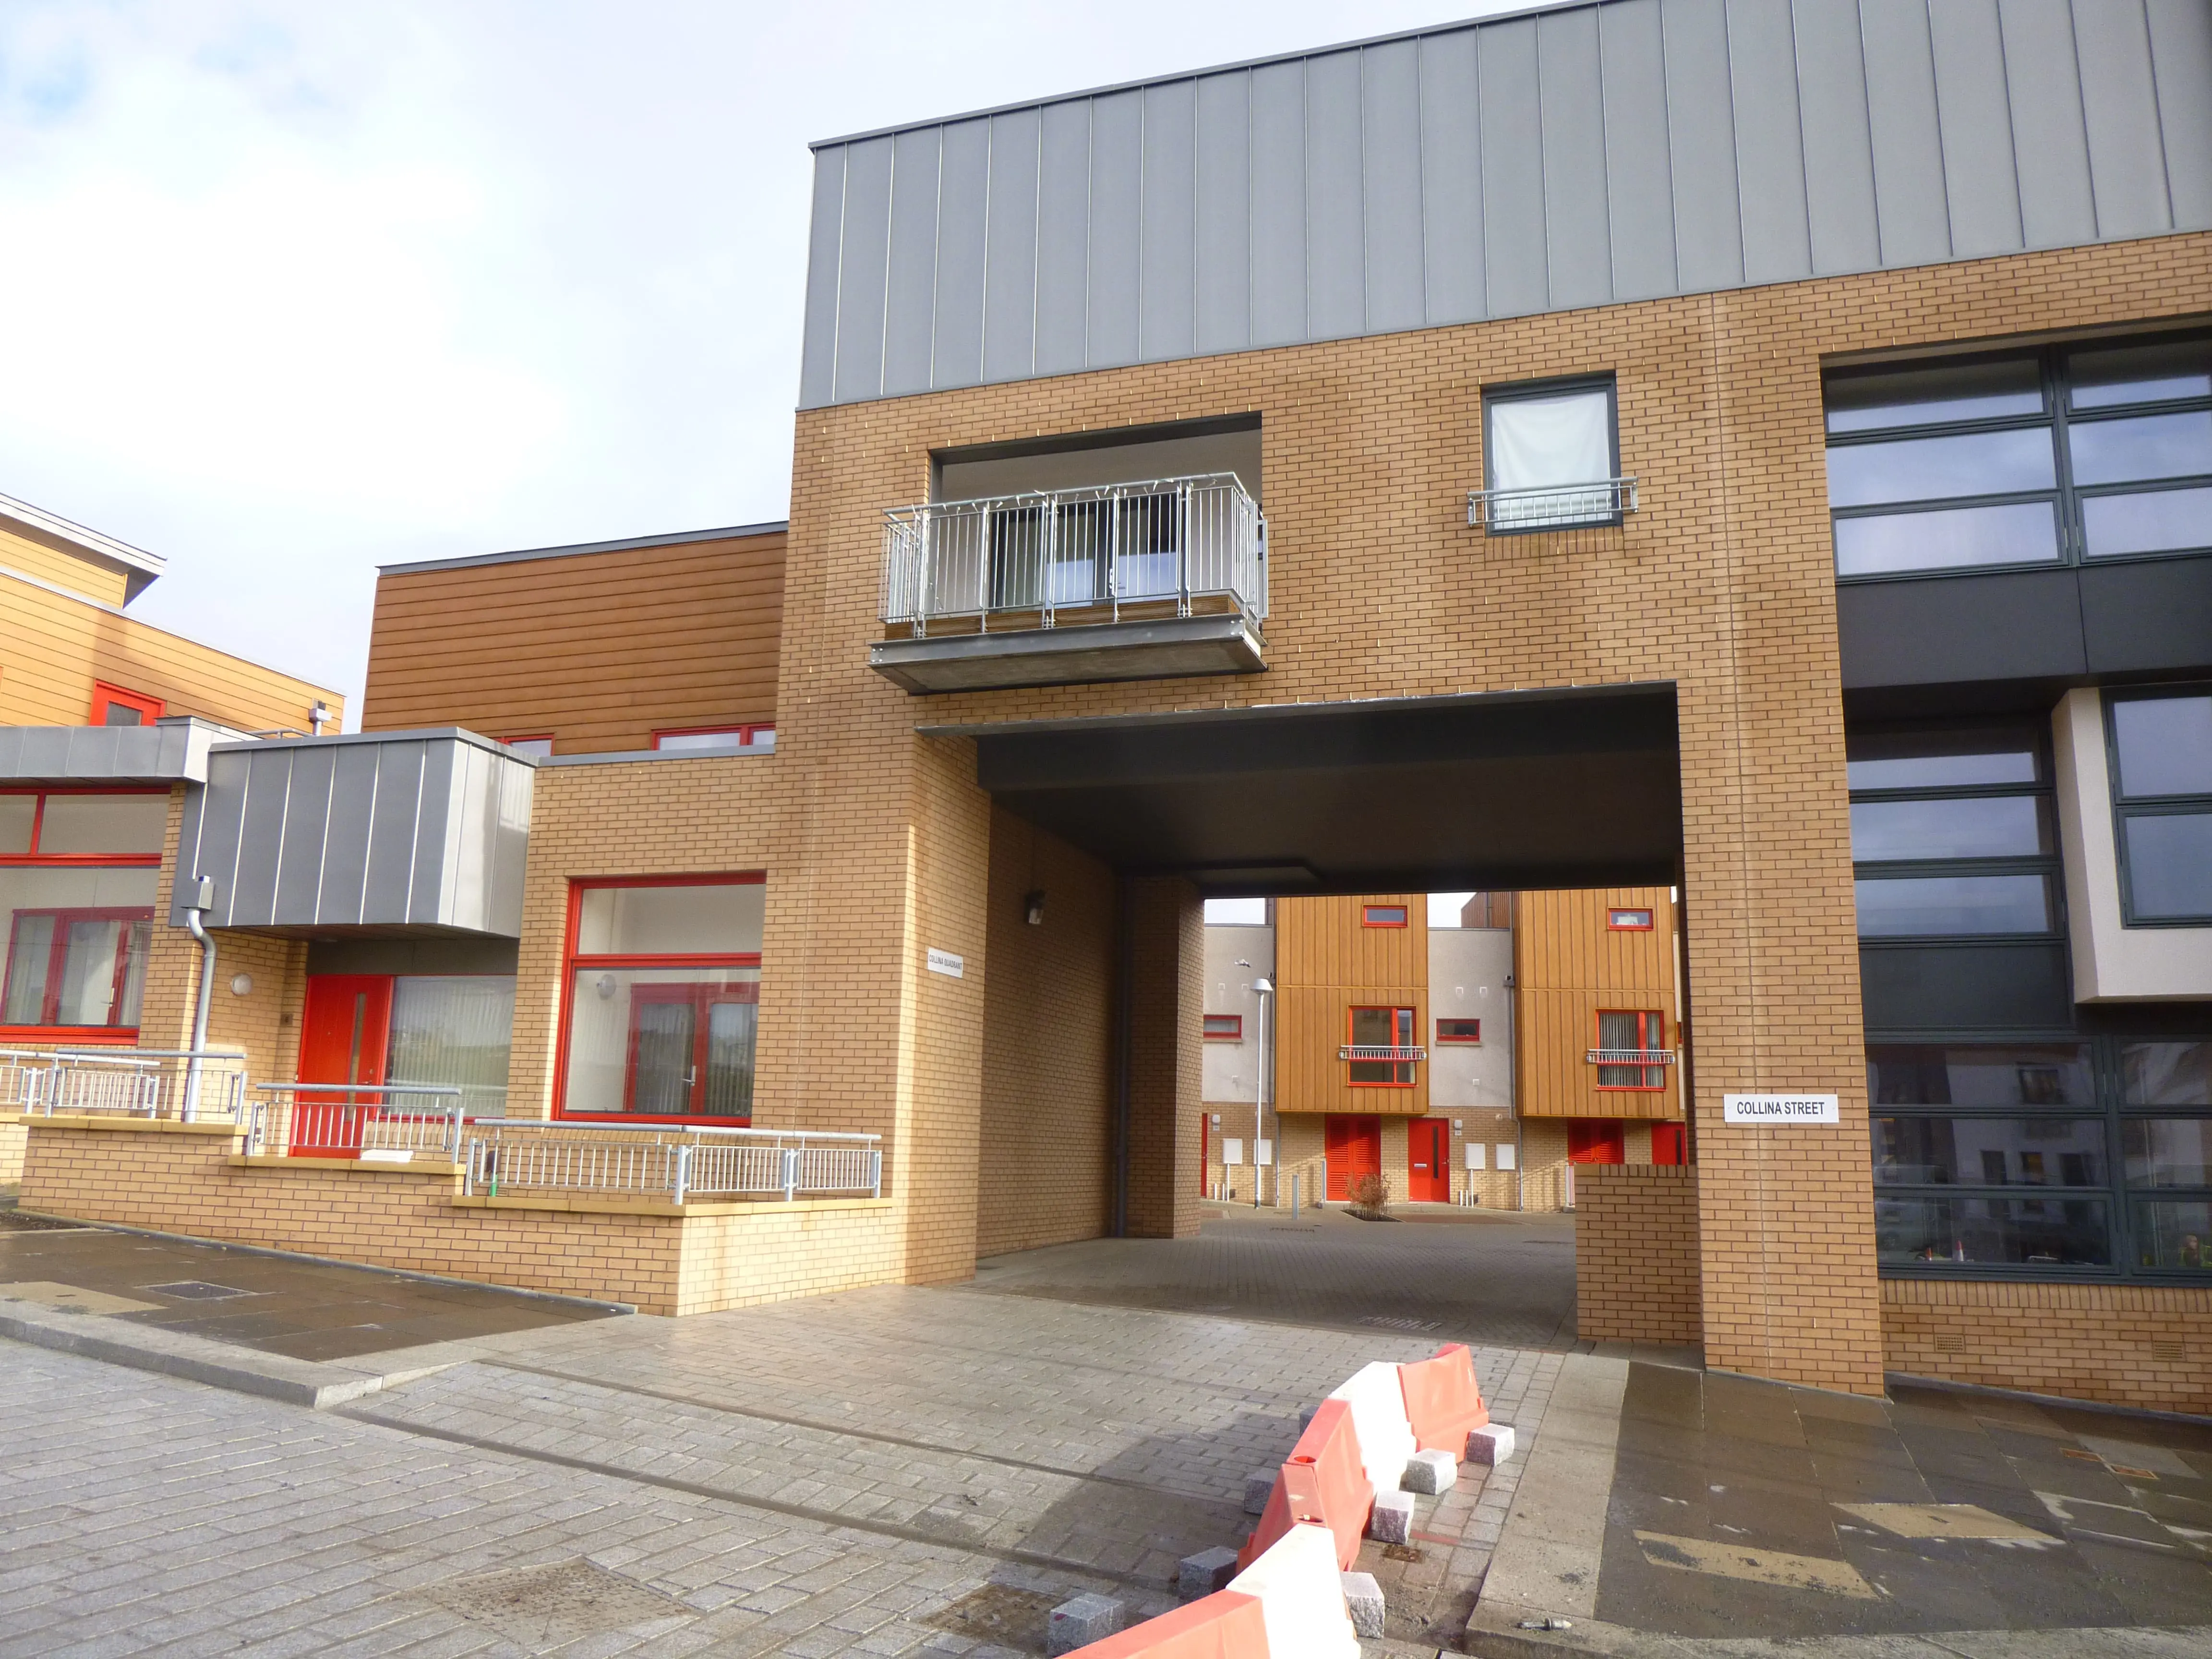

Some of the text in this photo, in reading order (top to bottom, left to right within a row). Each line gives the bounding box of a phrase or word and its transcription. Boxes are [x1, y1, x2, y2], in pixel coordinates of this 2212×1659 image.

[929, 954, 962, 970] COLLINA QUADRANT
[1737, 1102, 1825, 1115] COLLINA STREET
